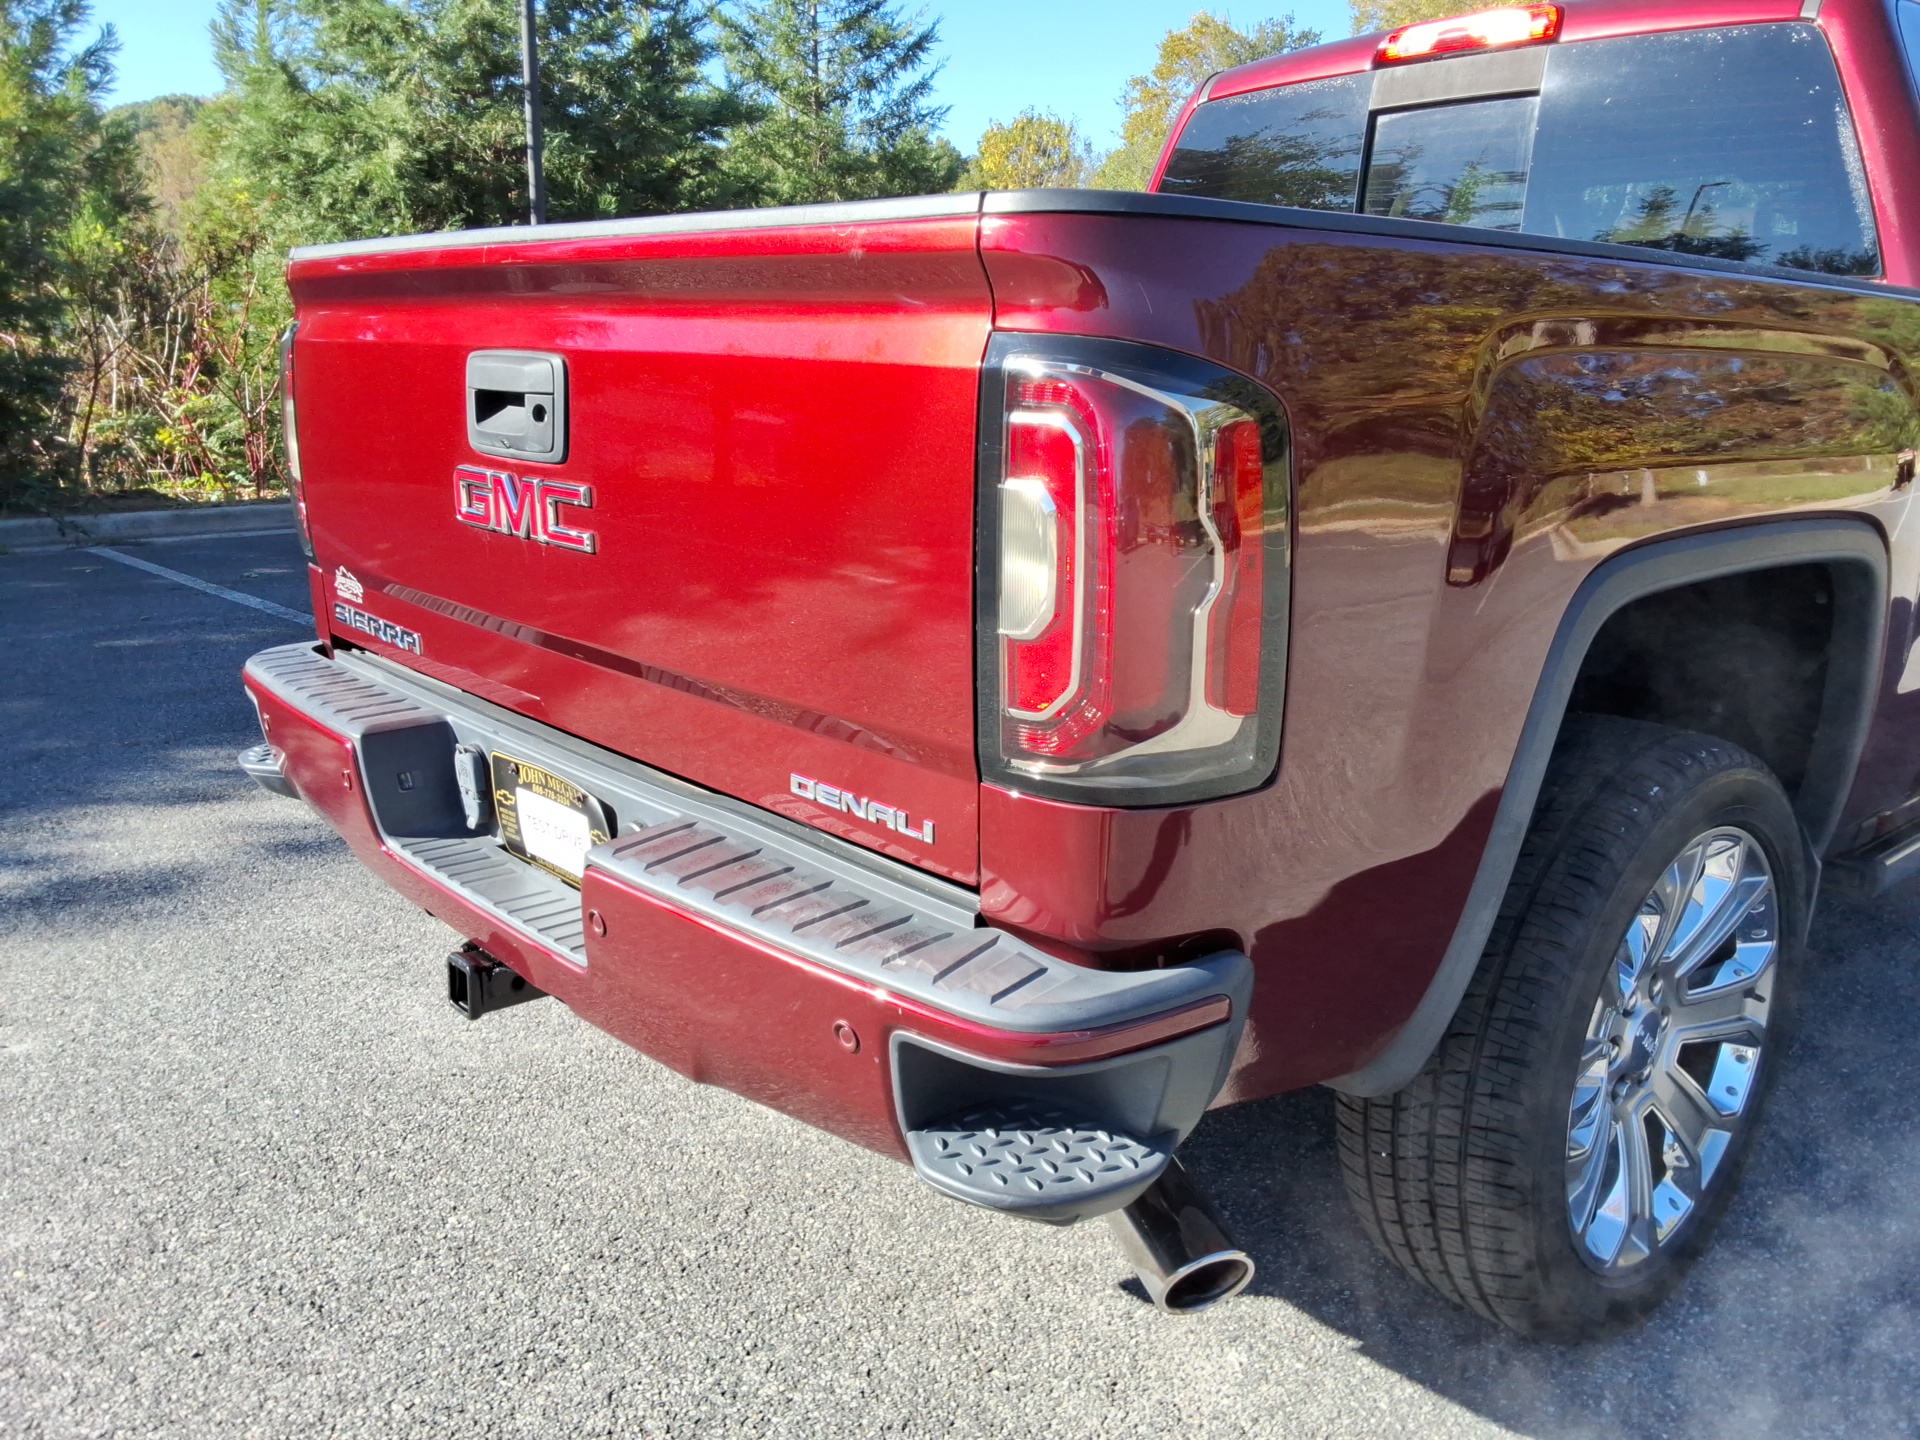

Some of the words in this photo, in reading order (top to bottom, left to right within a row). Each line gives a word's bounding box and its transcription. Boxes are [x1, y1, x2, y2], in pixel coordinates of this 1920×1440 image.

[454, 465, 597, 554] GMC
[334, 602, 423, 655] SIERRA
[518, 764, 546, 786] JOHN
[526, 813, 550, 836] TEST
[554, 826, 584, 851] DRIVE
[790, 772, 935, 844] DENALI
